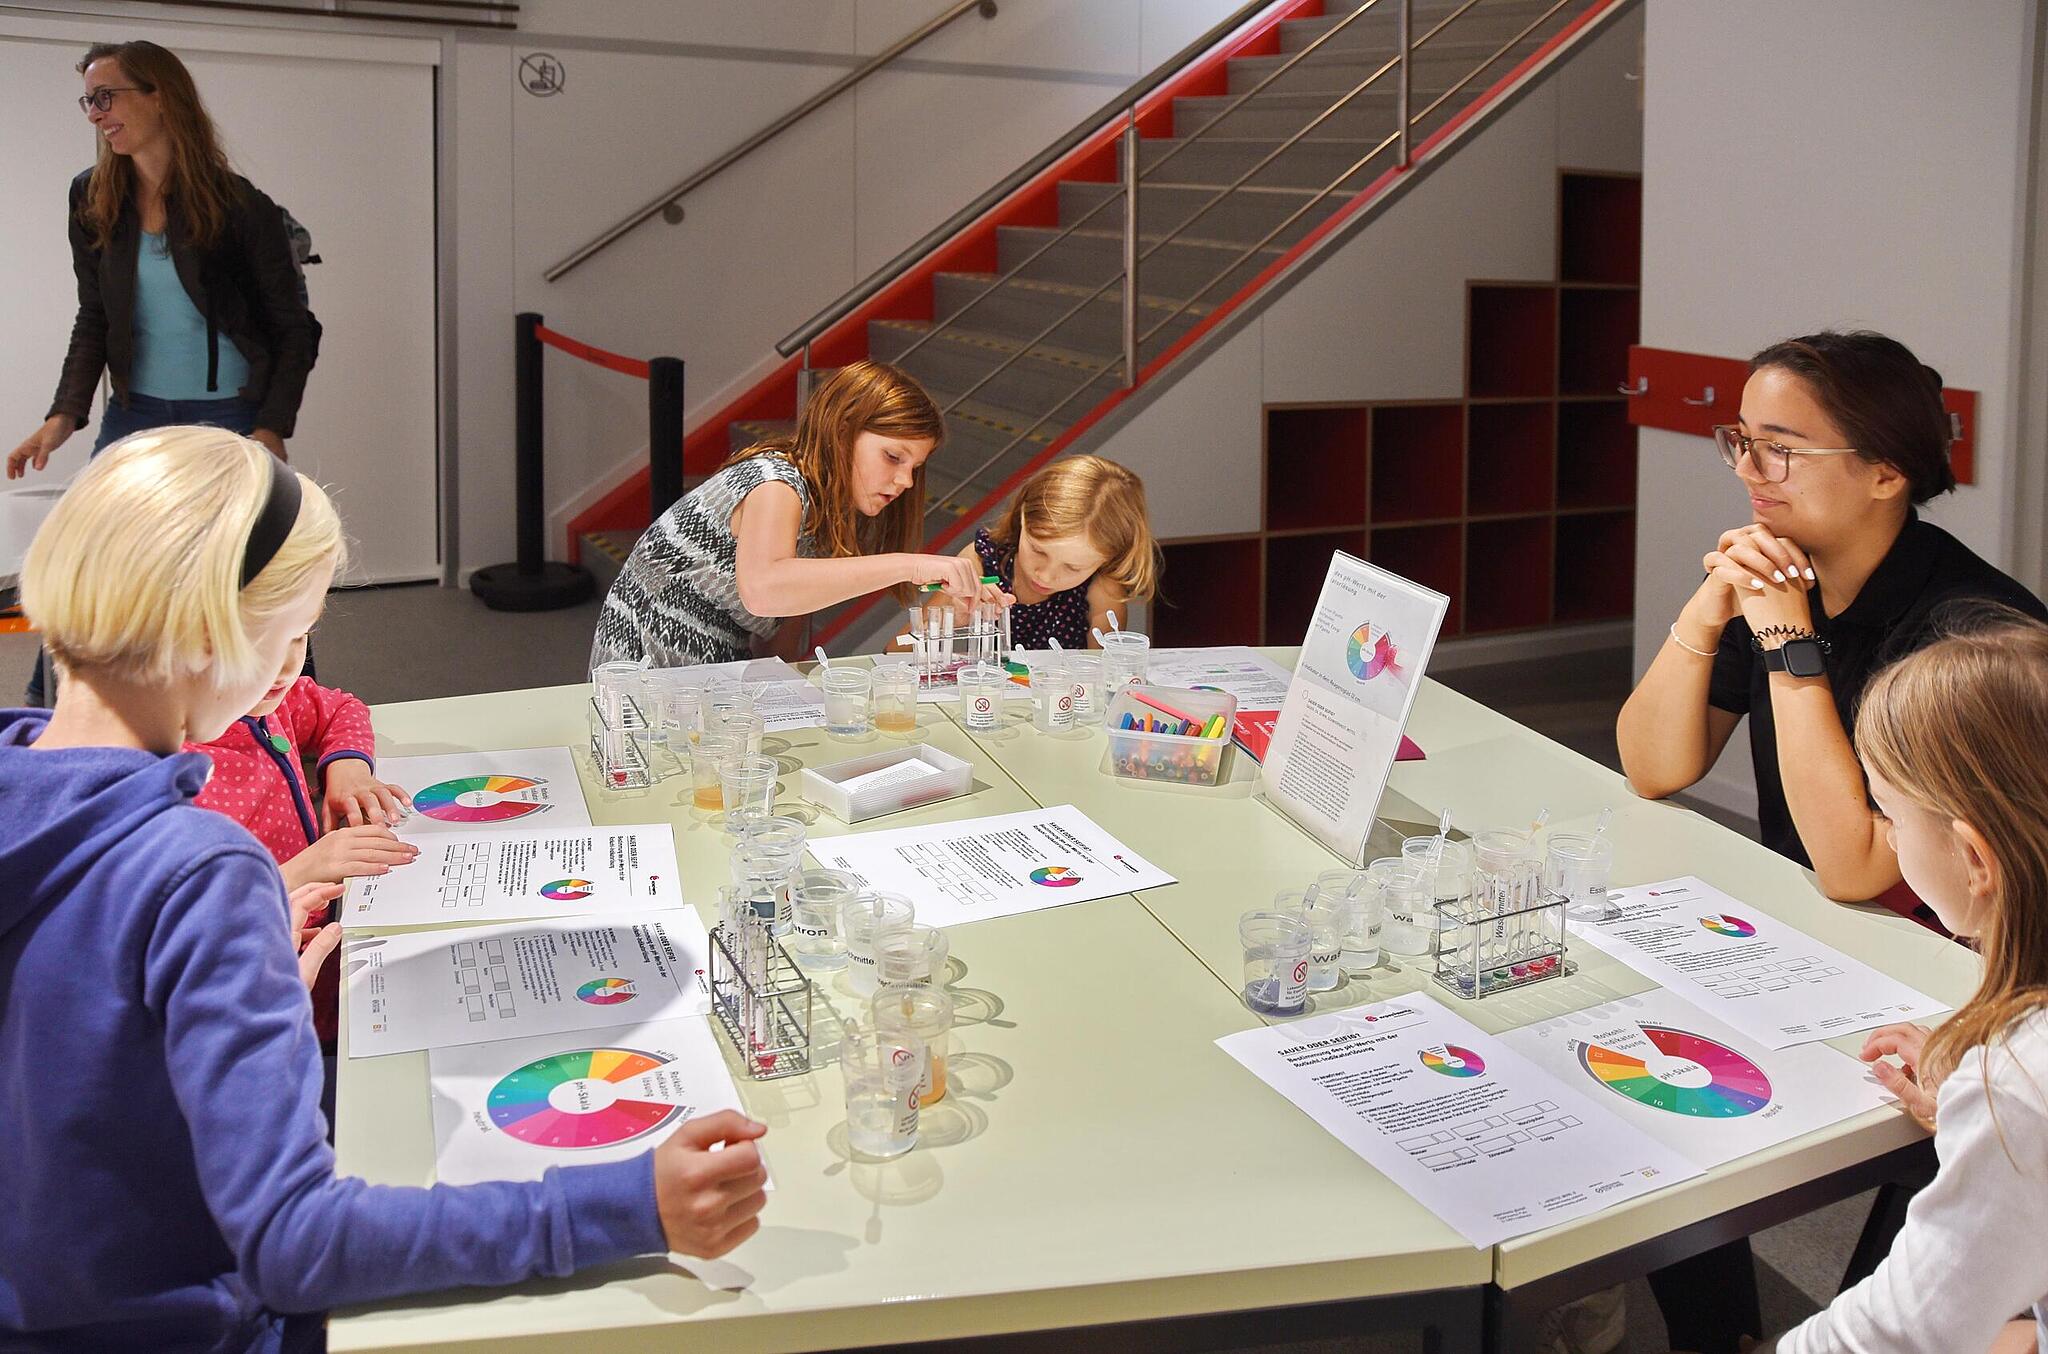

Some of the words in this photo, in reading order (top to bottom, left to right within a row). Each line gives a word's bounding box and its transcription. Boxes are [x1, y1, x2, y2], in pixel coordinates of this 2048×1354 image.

[1393, 913, 1413, 923] Wa
[659, 934, 671, 947] ODER
[662, 945, 677, 962] SEIFIG?
[1593, 1027, 1627, 1041] Rotkohl-
[1600, 1033, 1639, 1047] Indikator-
[1277, 1045, 1306, 1056] SAUER
[1306, 1039, 1330, 1049] ODER
[1330, 1033, 1361, 1044] SEIFIG?
[1616, 1039, 1647, 1051] lösung
[1287, 1050, 1331, 1063] Bestimmung
[1660, 1063, 1699, 1081] pH-Skala
[575, 1081, 591, 1110] pH-Skala
[1653, 1099, 1664, 1107] 10
